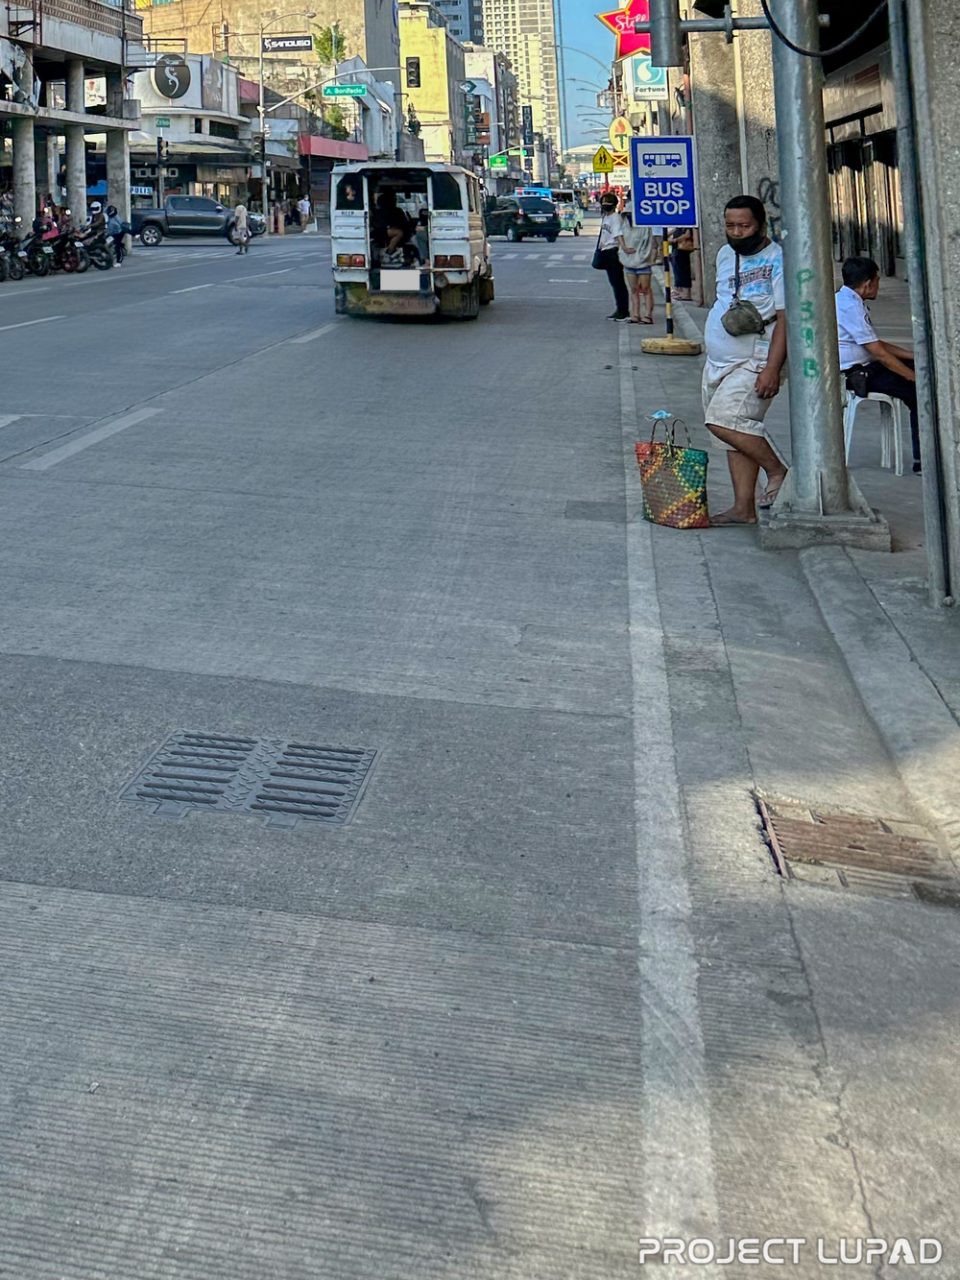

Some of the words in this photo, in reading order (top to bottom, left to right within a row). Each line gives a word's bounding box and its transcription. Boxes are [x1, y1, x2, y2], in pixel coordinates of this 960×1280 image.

[523, 107, 532, 144] HOTEL
[644, 182, 684, 197] BUS
[640, 200, 690, 215] STOP
